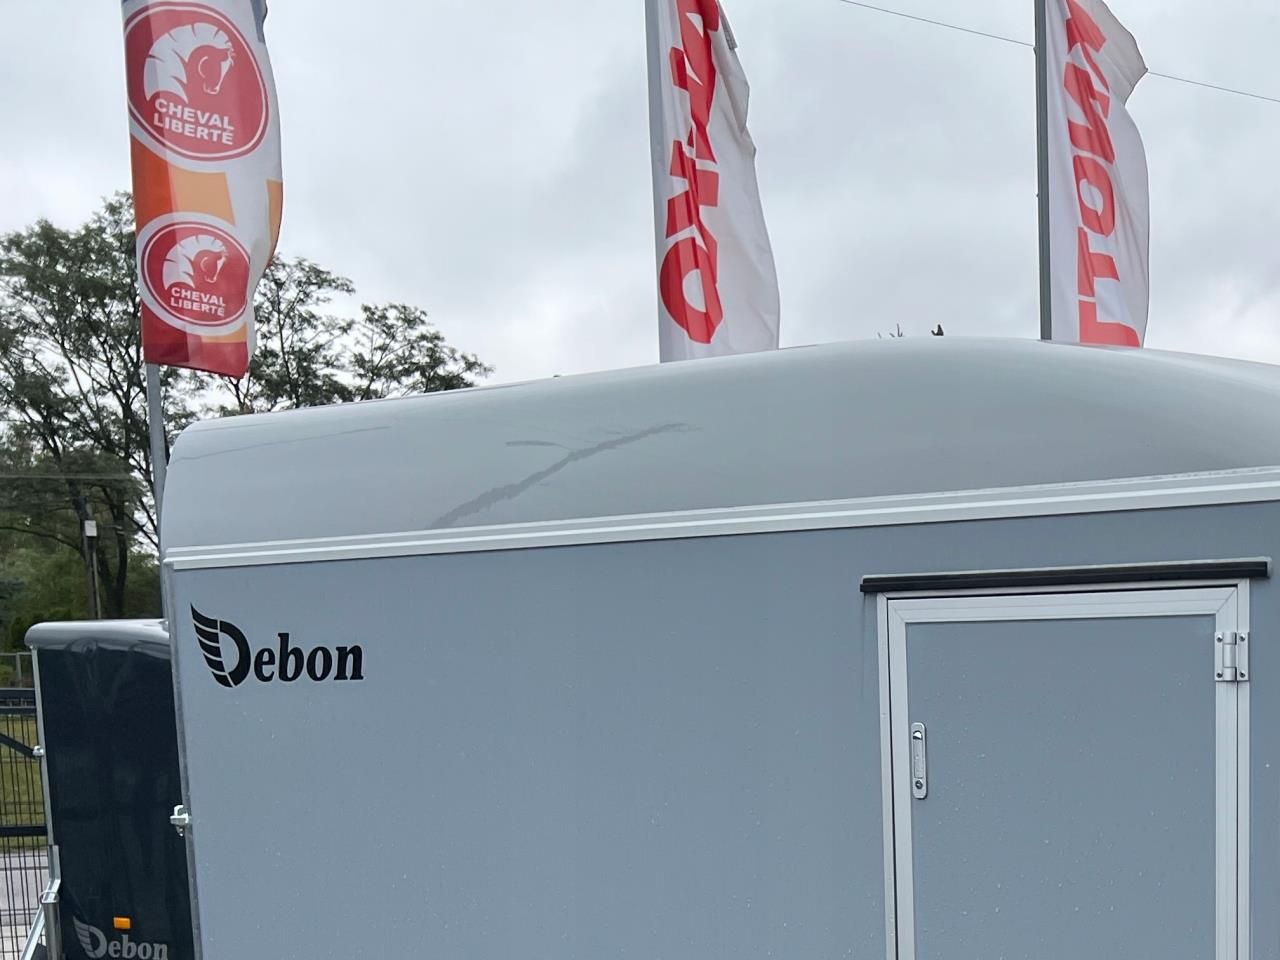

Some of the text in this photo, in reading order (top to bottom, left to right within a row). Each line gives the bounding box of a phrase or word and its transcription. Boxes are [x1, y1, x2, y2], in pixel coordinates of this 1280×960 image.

[154, 98, 235, 131] CHEVAL
[171, 287, 226, 306] CHEVAL
[190, 602, 364, 688] Debon
[73, 916, 168, 960] Debon
